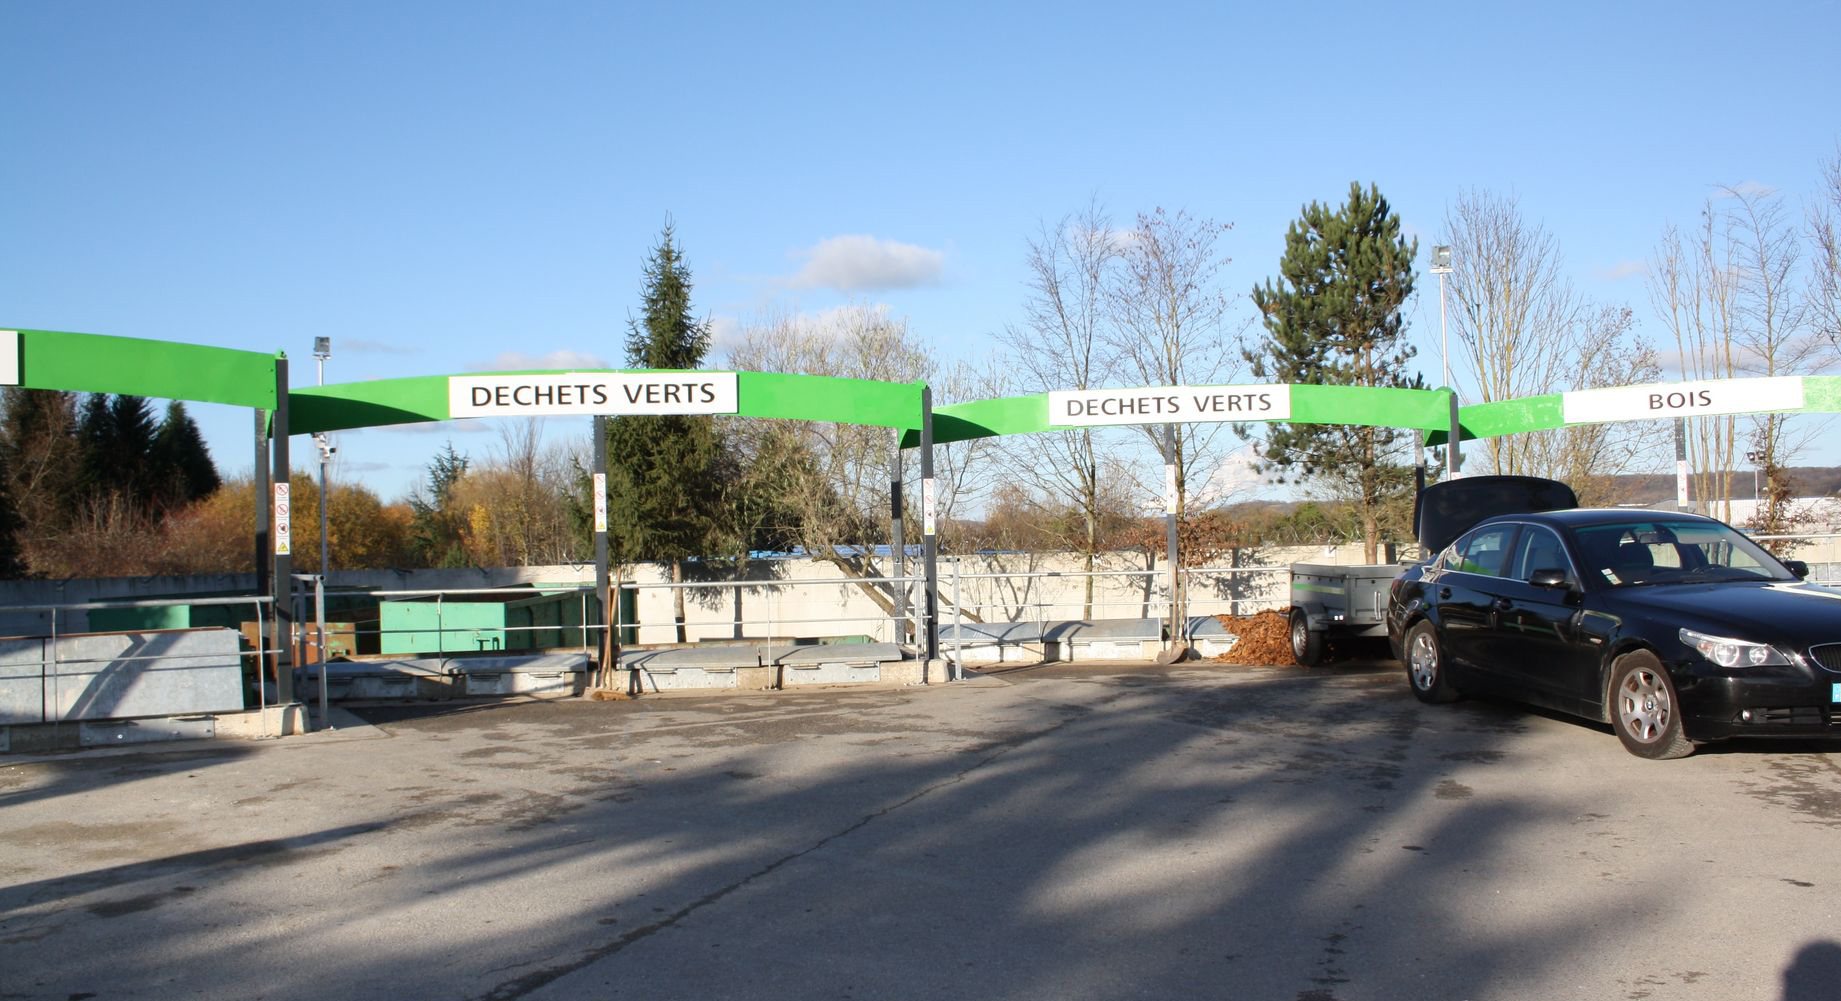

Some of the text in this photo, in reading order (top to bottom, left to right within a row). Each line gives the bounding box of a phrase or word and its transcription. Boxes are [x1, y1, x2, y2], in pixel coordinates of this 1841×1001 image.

[471, 382, 715, 407] DECHETS VERTS
[1067, 394, 1272, 416] DECHETS VERTS
[1649, 390, 1712, 410] BOIS
